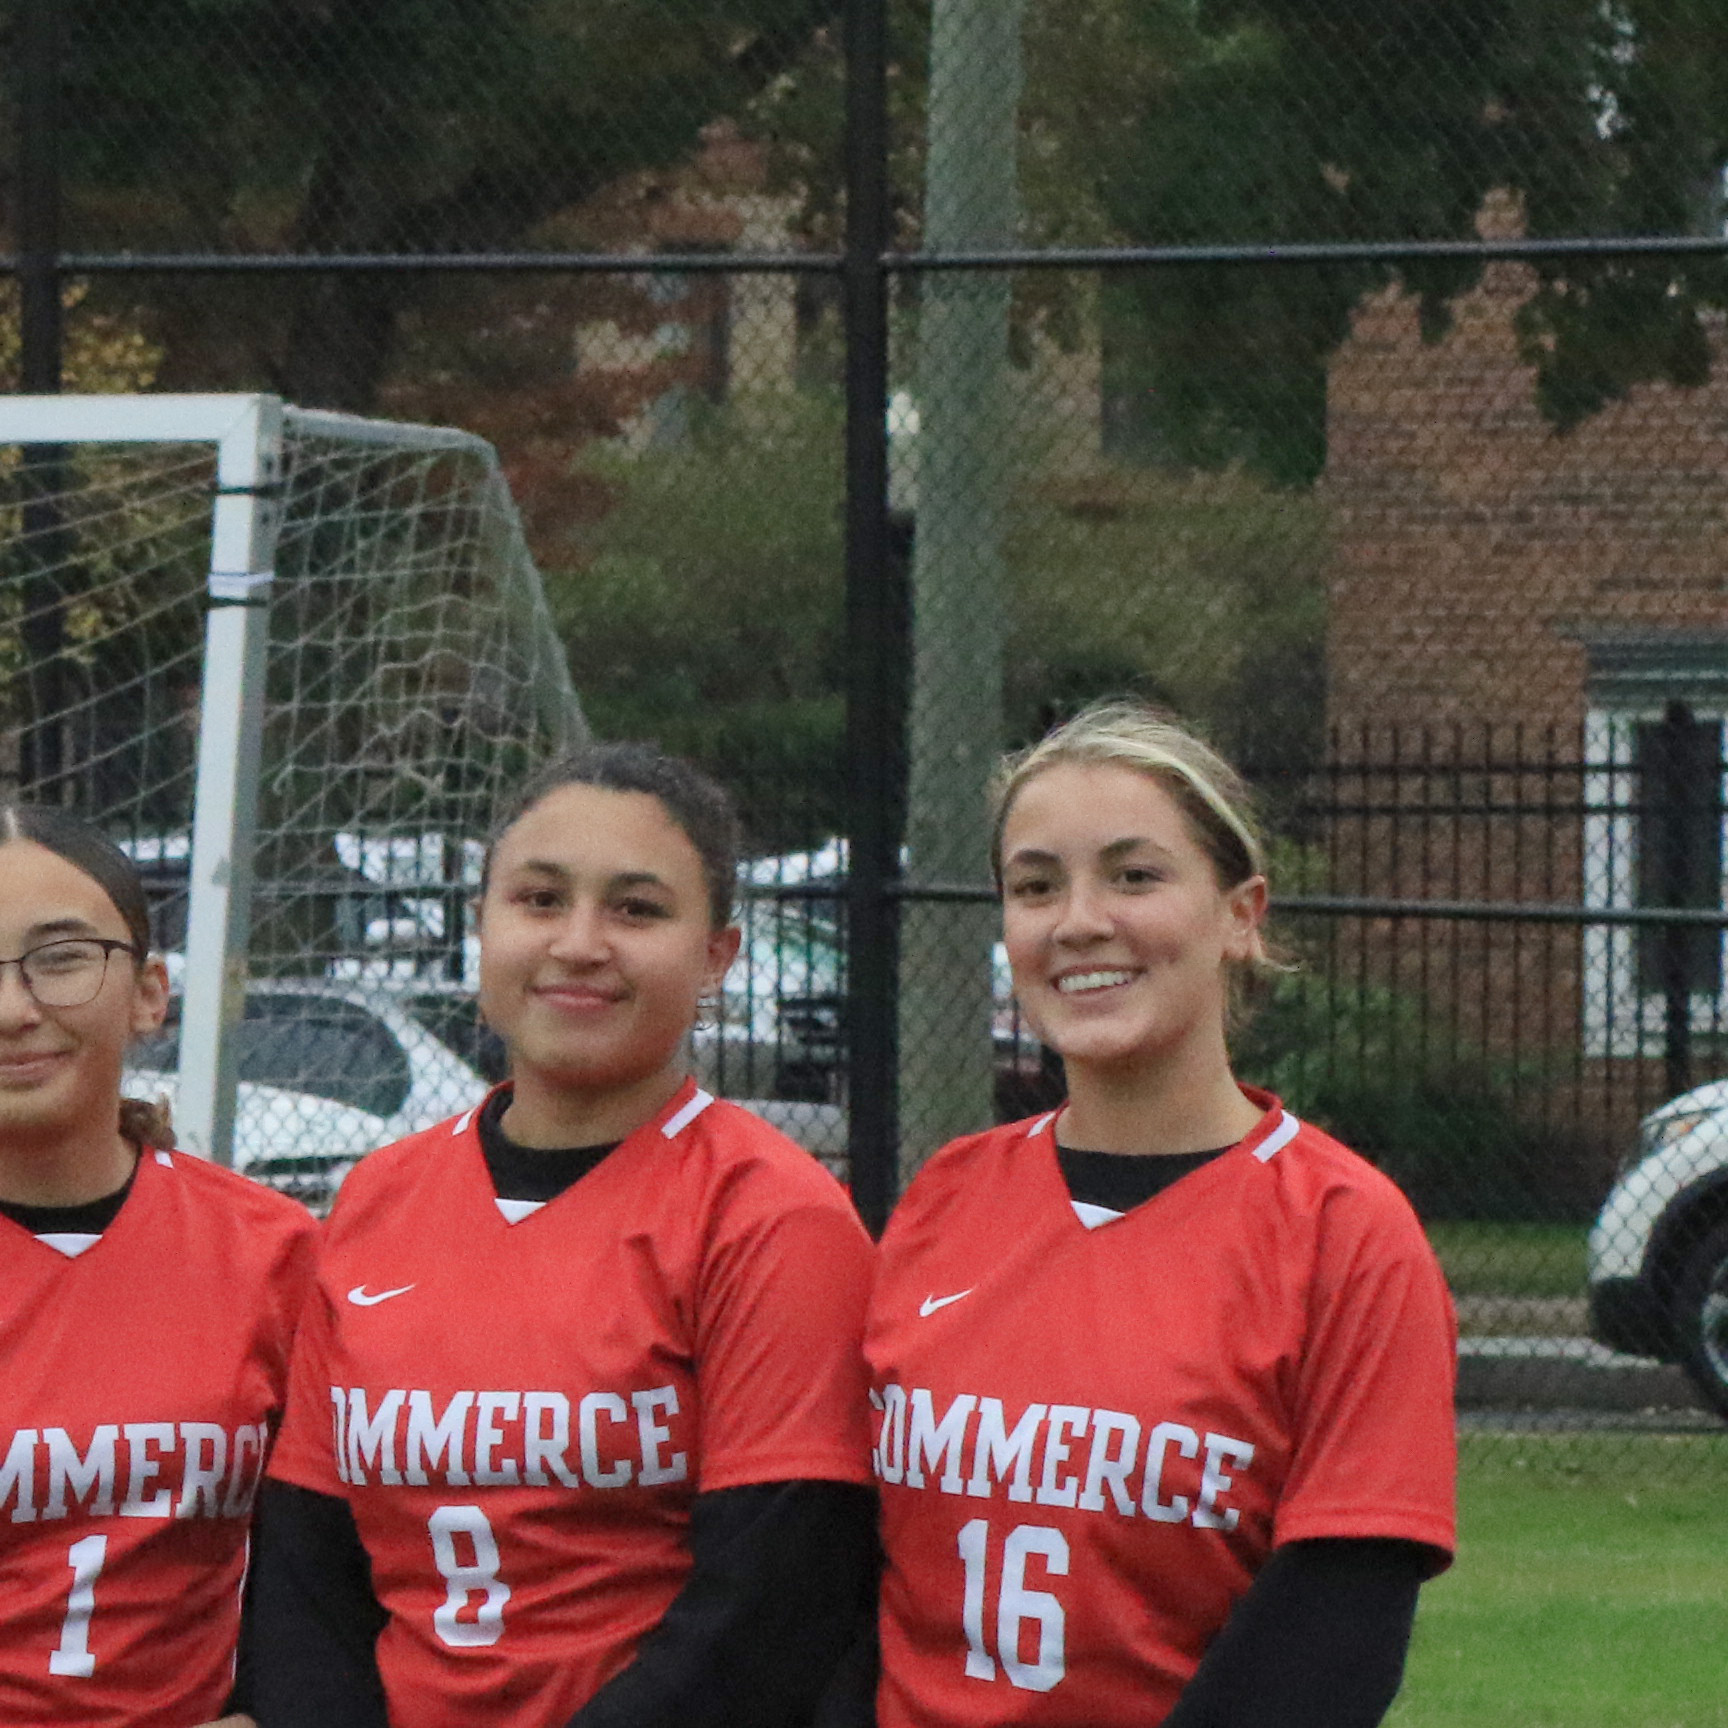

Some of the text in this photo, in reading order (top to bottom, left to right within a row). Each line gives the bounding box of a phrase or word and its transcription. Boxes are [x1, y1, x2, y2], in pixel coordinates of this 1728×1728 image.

[49, 1534, 107, 1678] 1
[427, 1505, 511, 1647] 8
[957, 1518, 1070, 1692] 16
